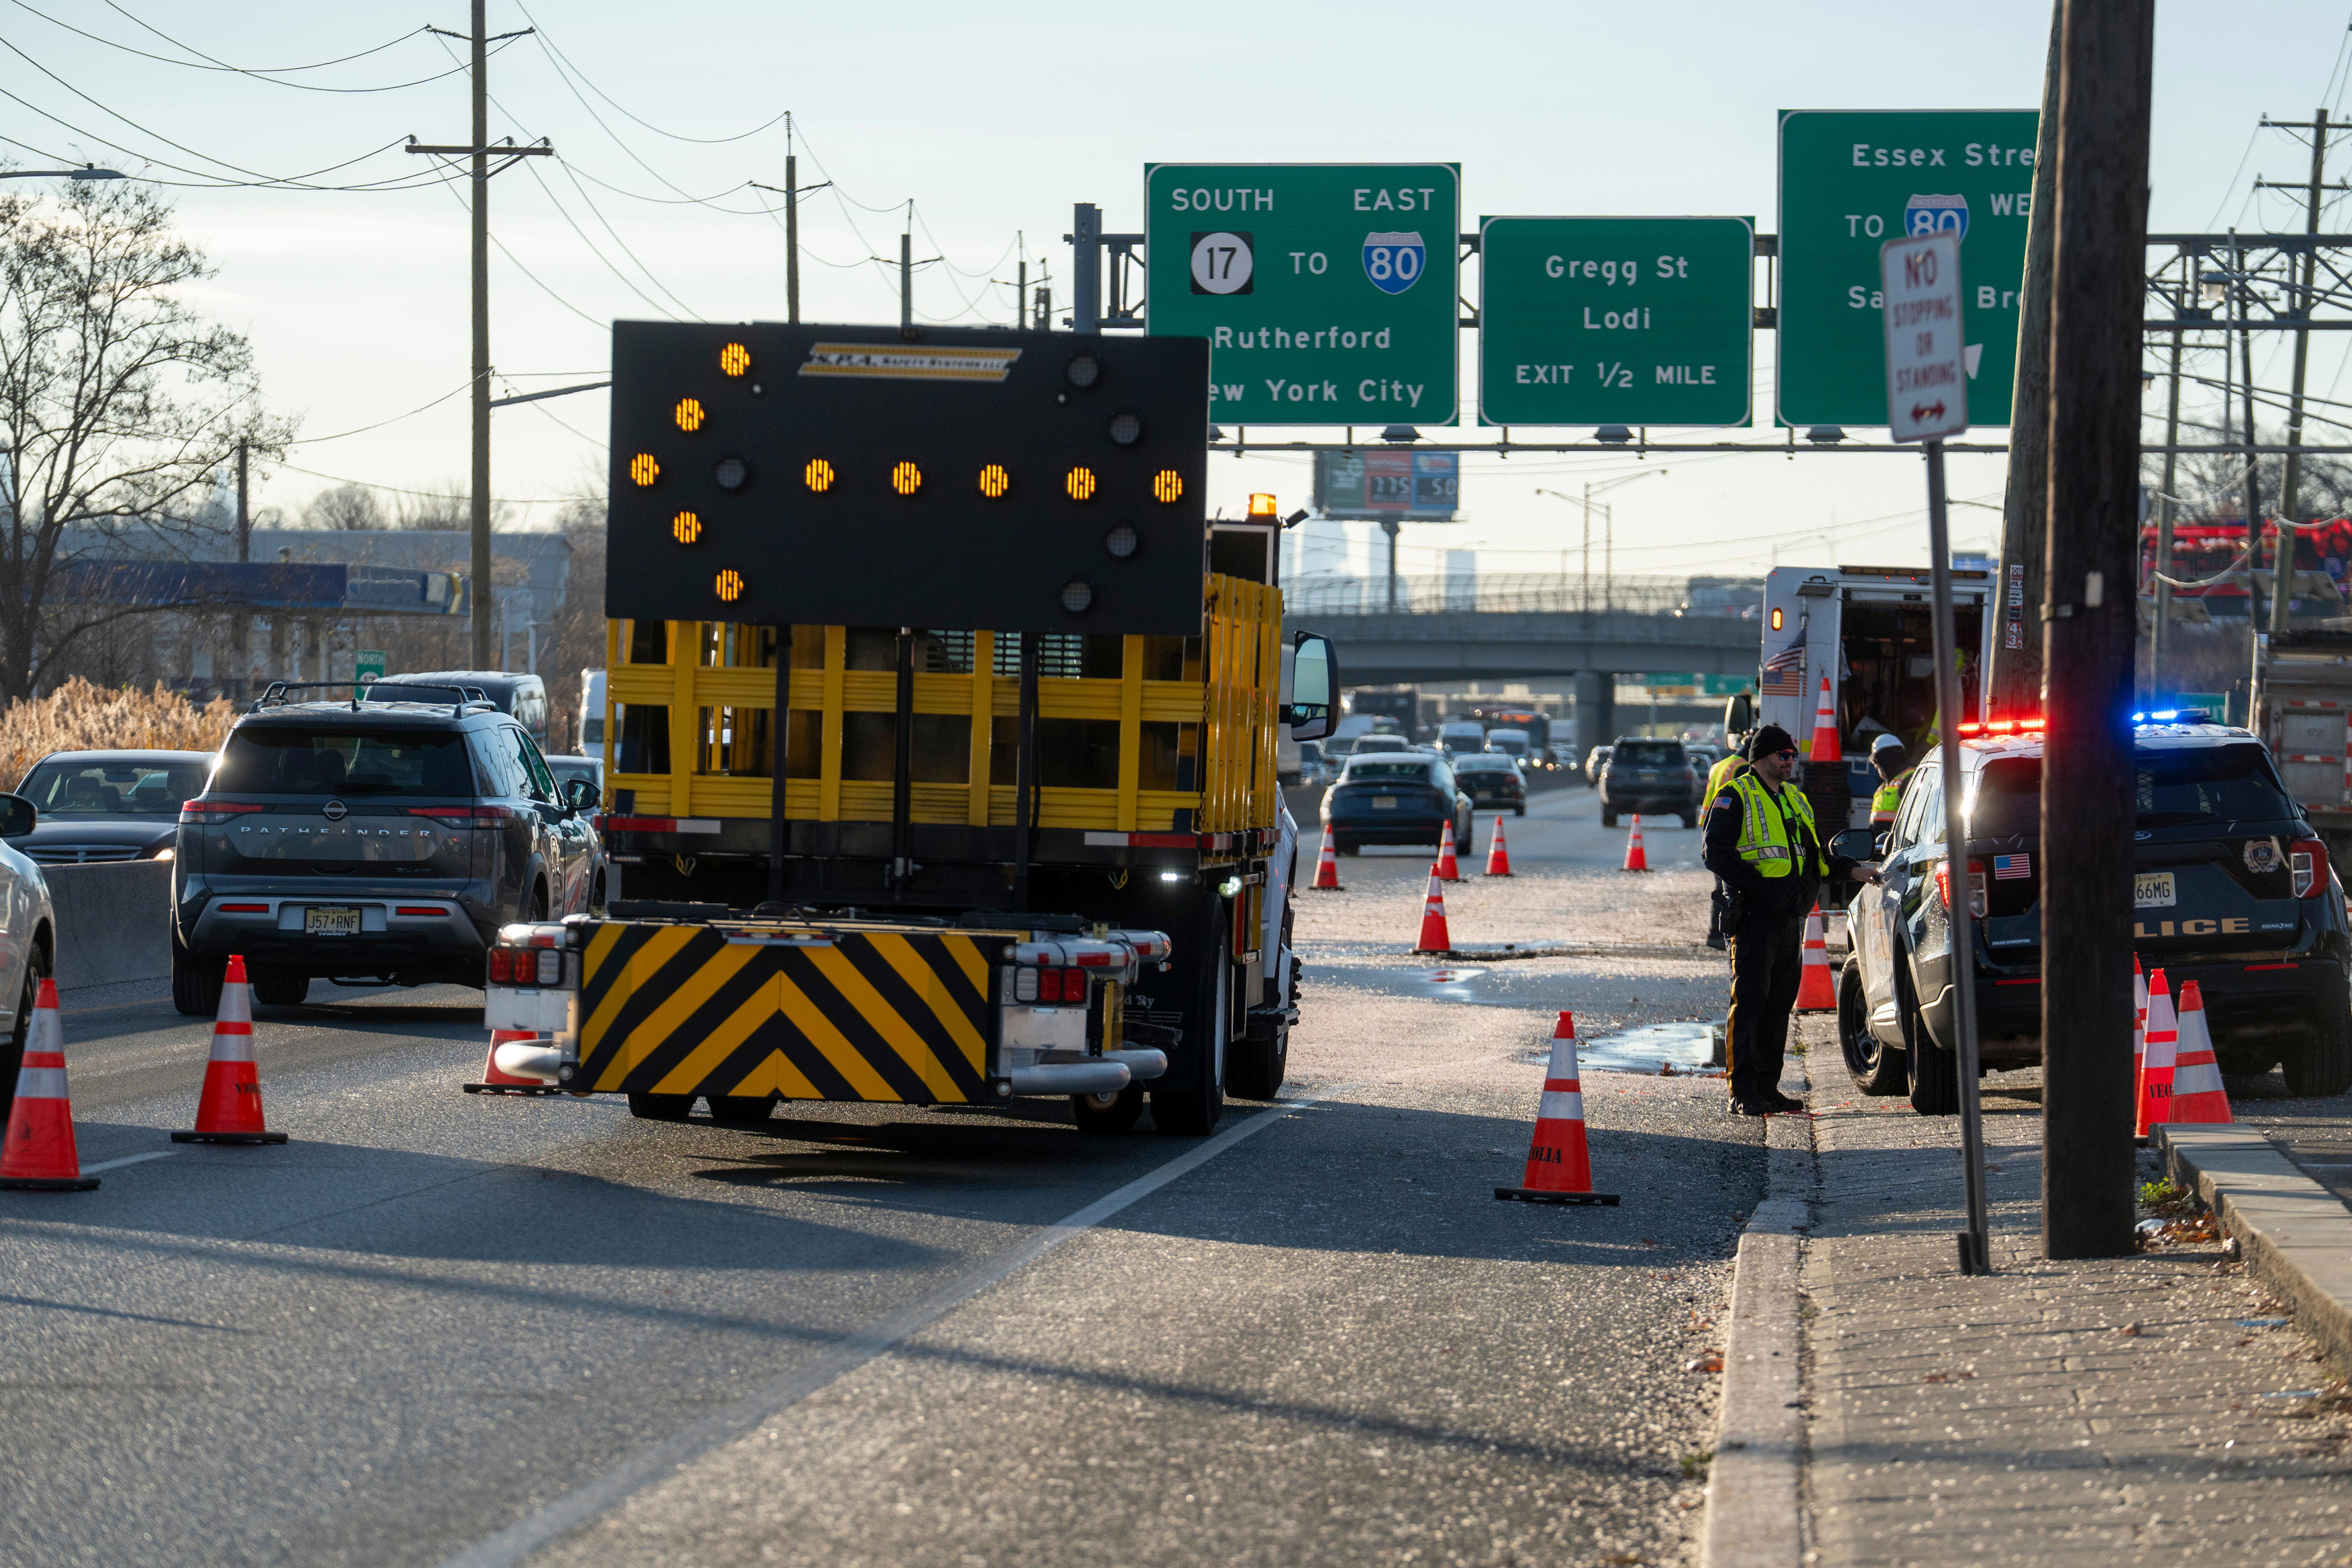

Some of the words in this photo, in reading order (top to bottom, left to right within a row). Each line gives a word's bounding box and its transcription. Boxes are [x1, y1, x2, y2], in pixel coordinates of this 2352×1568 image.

[1853, 144, 1945, 167] Essex
[1965, 143, 2034, 167] Stre
[1172, 188, 1273, 211] SOUTH
[1354, 188, 1434, 211] EAST
[1990, 193, 2031, 216] WE
[1845, 215, 1883, 237] TO
[1912, 210, 1962, 238] 80
[1207, 247, 1236, 279] 17
[1289, 252, 1328, 274] TO
[1370, 247, 1418, 280] 80
[1546, 256, 1637, 286] Gregg
[1656, 256, 1688, 278] St
[1904, 247, 1937, 290] NO
[1584, 307, 1650, 329] Lodi
[1893, 293, 1953, 328] STOPPING
[1215, 326, 1391, 349] Rutherford
[1915, 330, 1933, 358] OR
[1516, 365, 1574, 384] EXIT
[1656, 366, 1716, 385] MILE
[1896, 360, 1956, 394] STANDING
[1208, 384, 1245, 402] ew
[1265, 379, 1338, 402] York
[1359, 379, 1424, 408] City
[357, 653, 384, 665] NORTH
[241, 826, 429, 837] PATHFINDER
[2135, 881, 2170, 899] 66MG
[308, 915, 329, 928] J57
[336, 915, 357, 928] RNF
[2134, 918, 2250, 937] LICE
[236, 1083, 260, 1094] VEO
[2150, 1083, 2172, 1099] VEO
